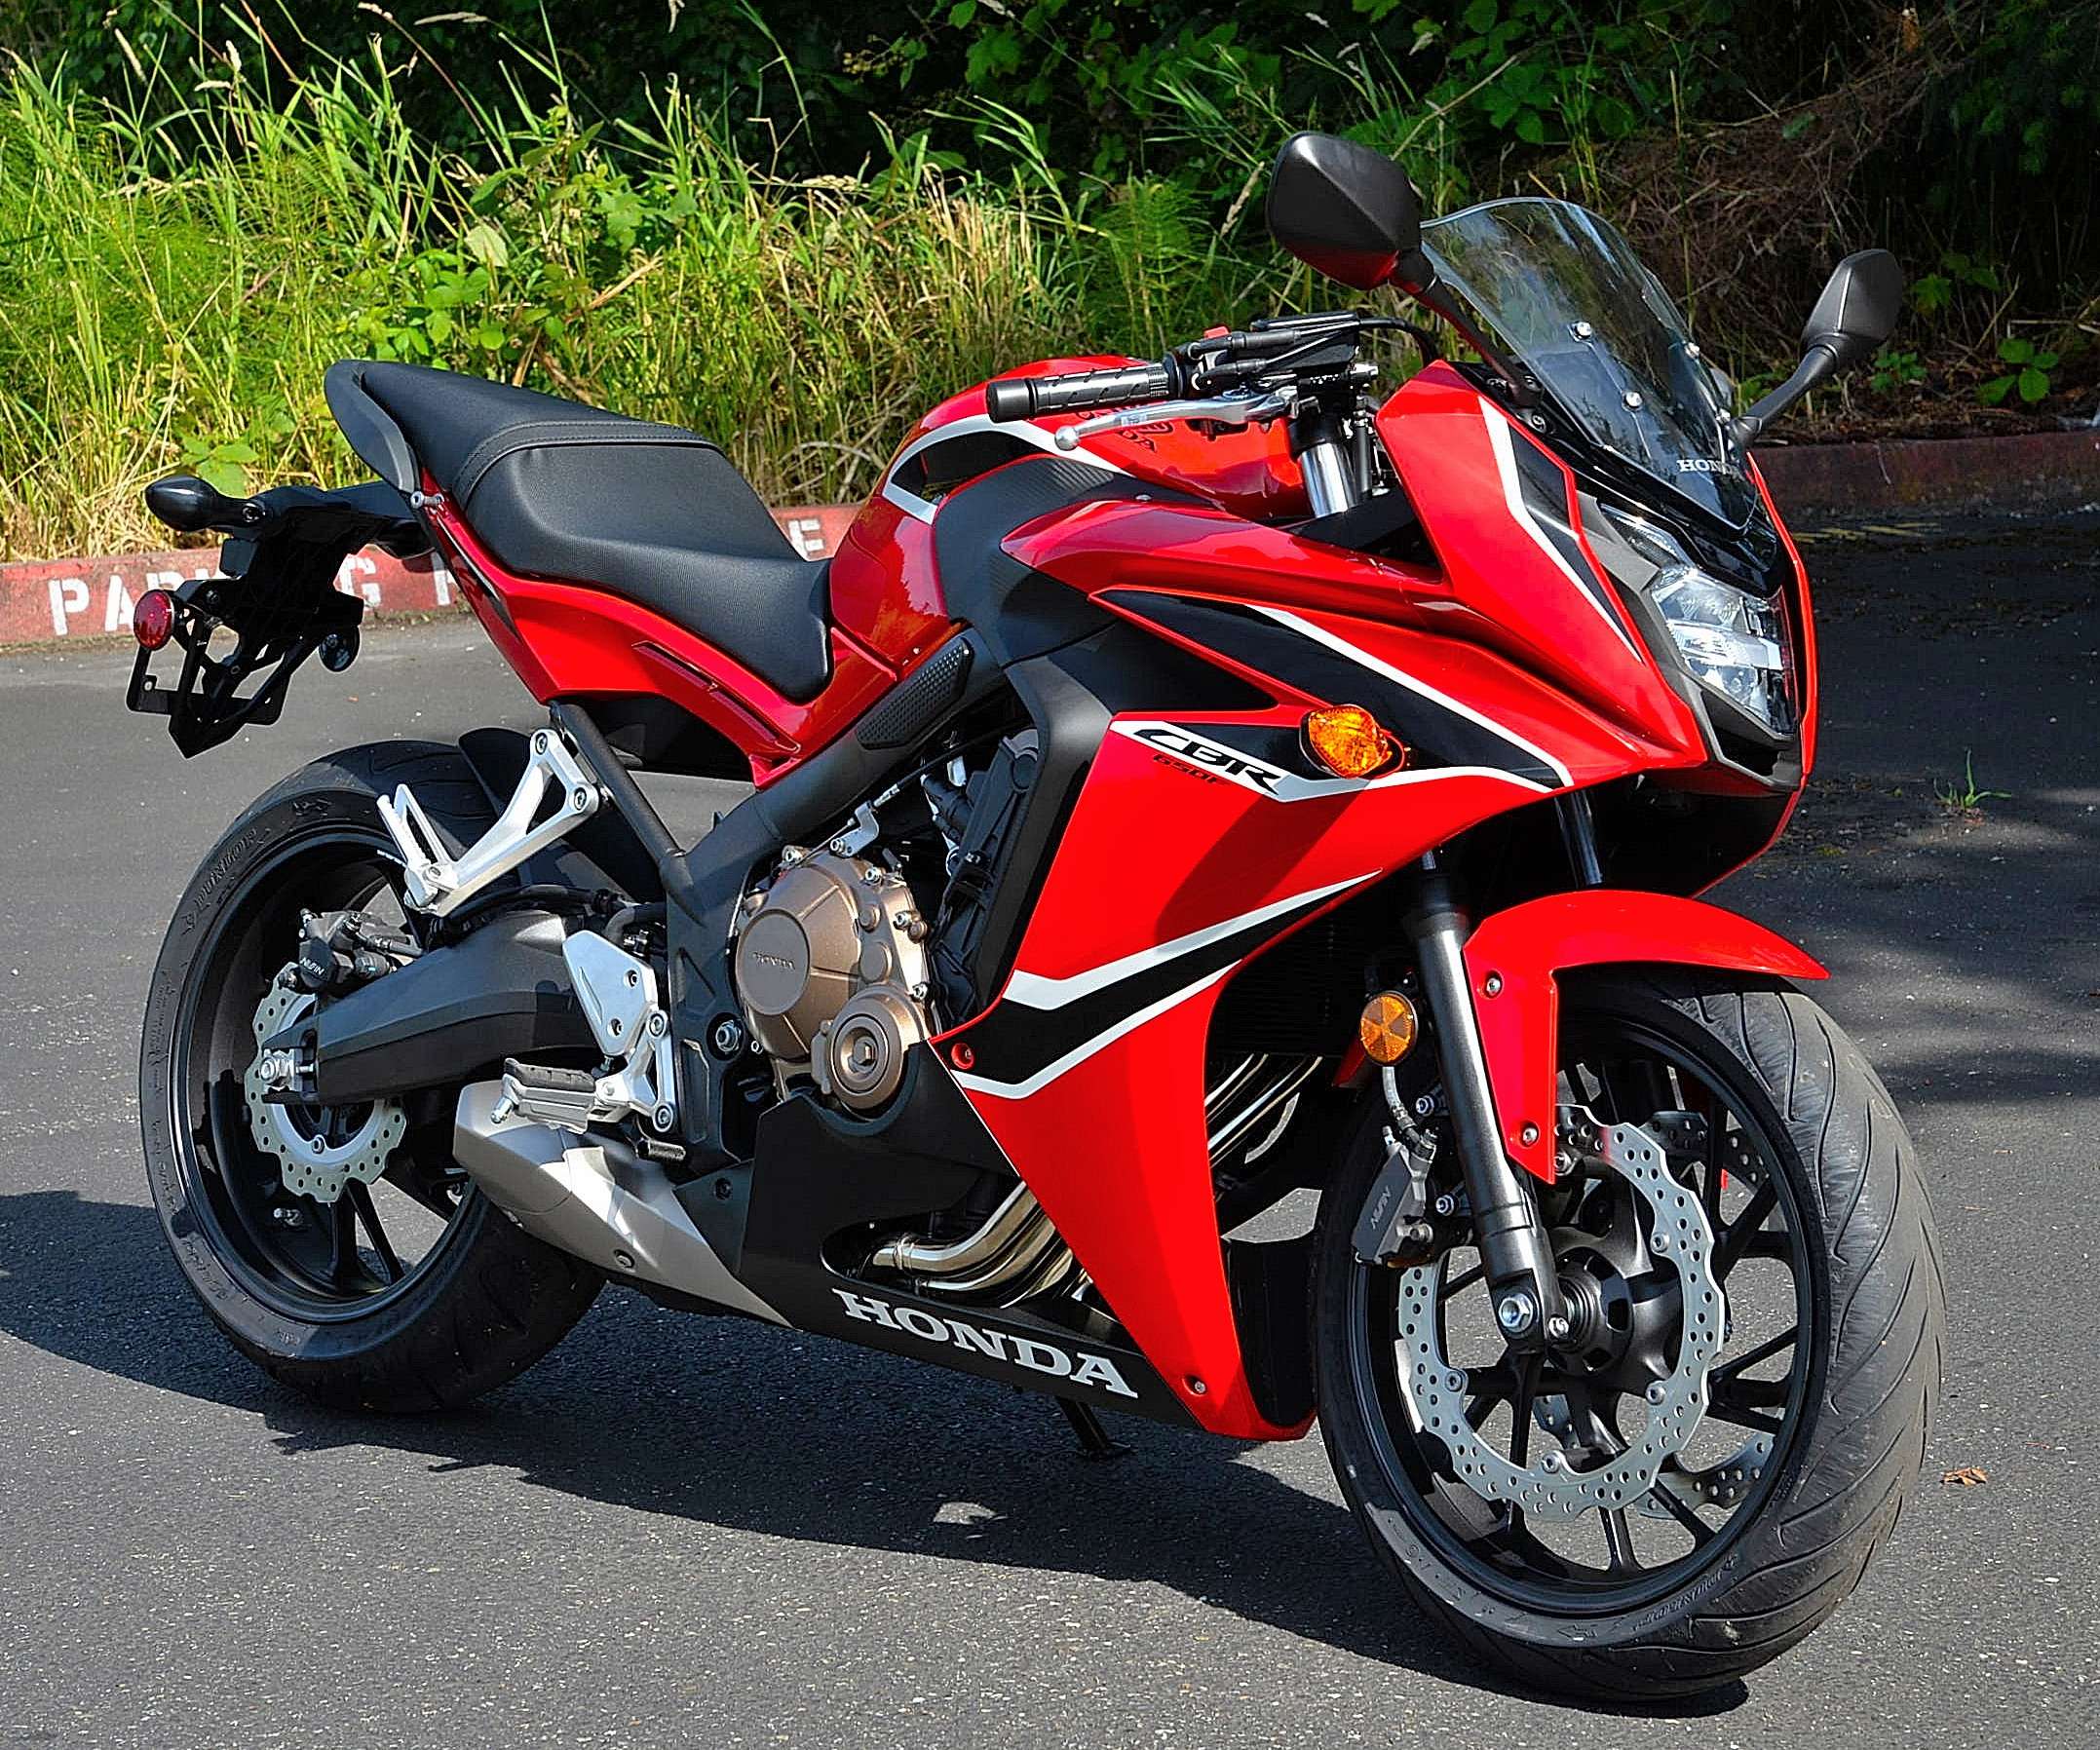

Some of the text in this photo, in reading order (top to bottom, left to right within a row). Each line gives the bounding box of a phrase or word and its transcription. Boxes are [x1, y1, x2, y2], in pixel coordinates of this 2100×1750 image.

[1676, 459, 1745, 481] HONDA
[1133, 729, 1281, 796] CBR
[831, 1288, 1138, 1399] HONDA
